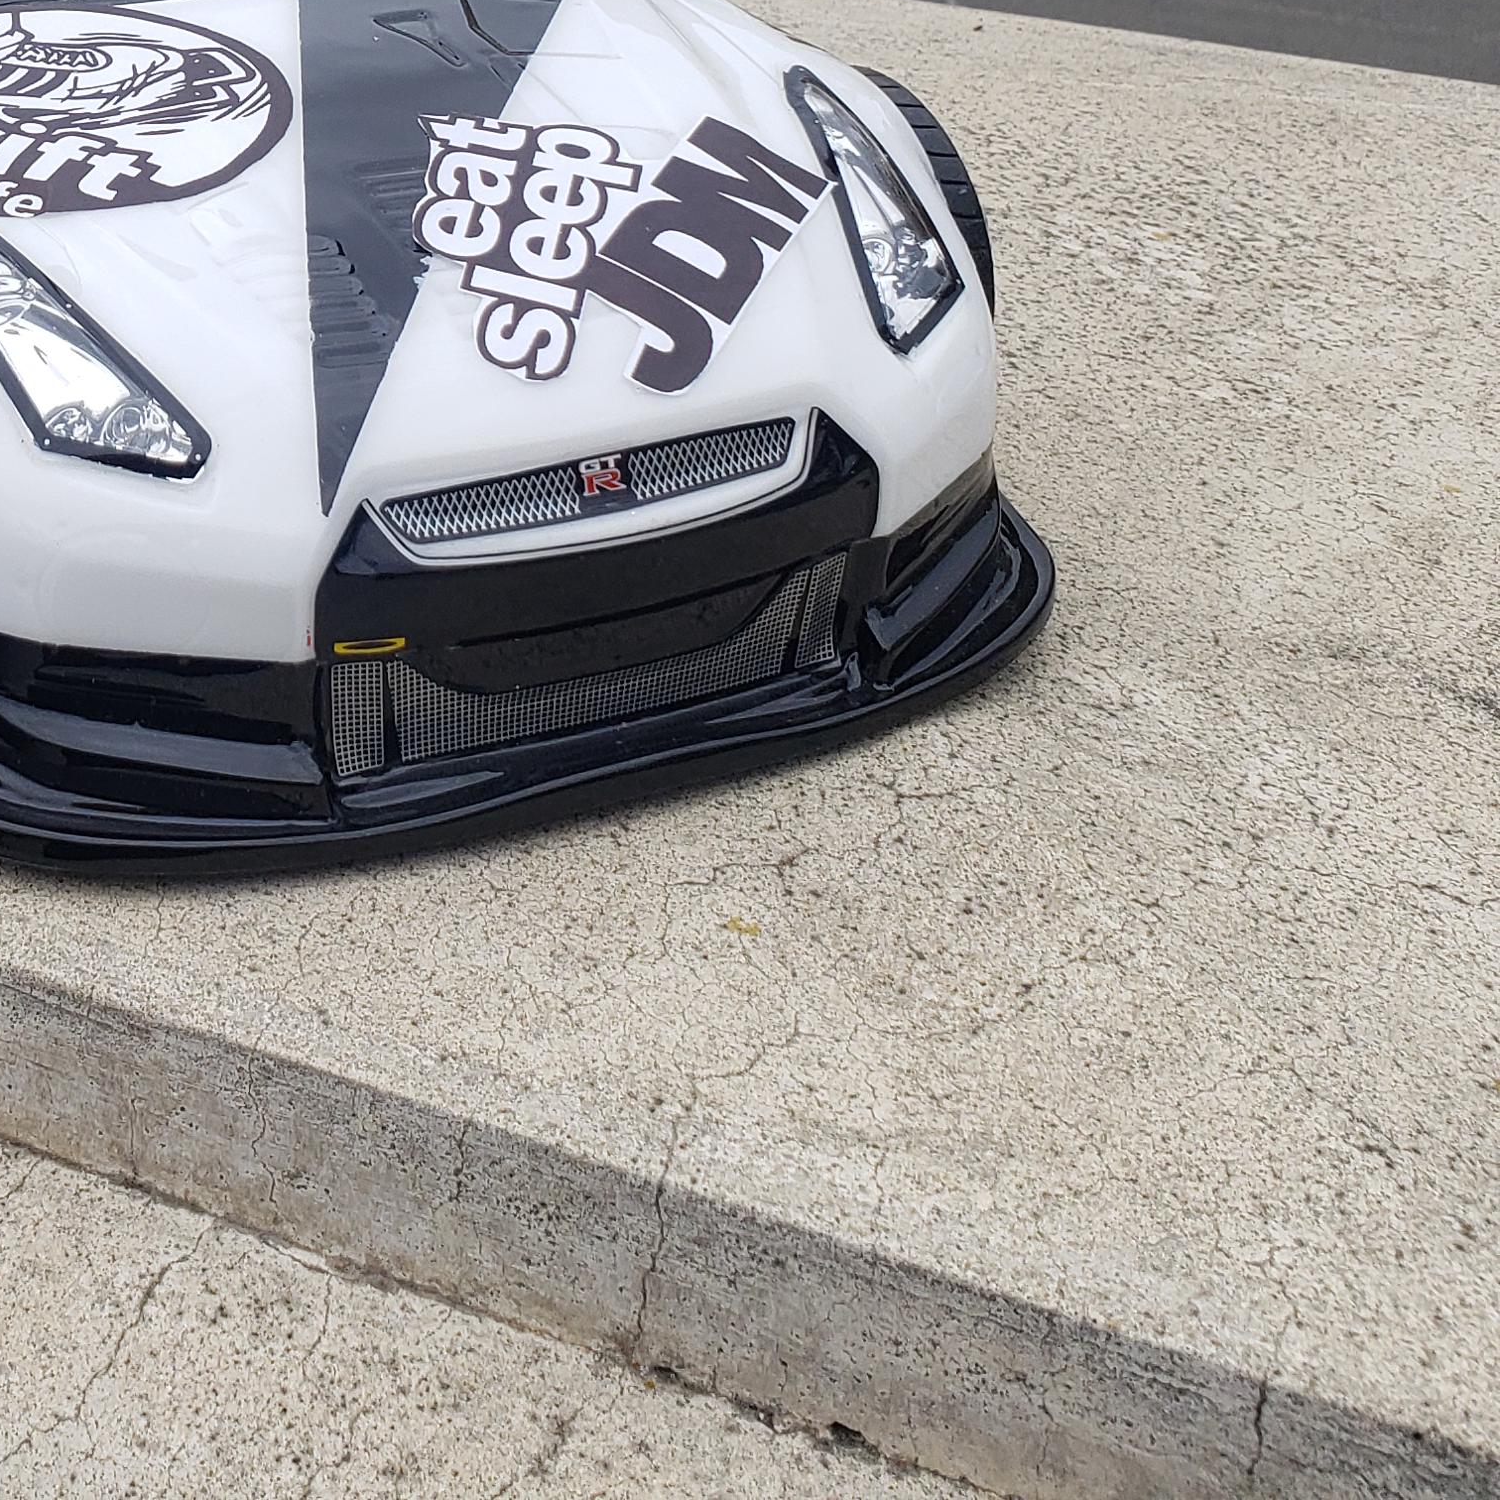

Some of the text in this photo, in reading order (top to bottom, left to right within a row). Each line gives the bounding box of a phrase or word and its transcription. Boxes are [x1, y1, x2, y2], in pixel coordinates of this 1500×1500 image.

[420, 118, 529, 258] eat
[474, 127, 634, 376] sleep
[587, 116, 830, 393] JDM
